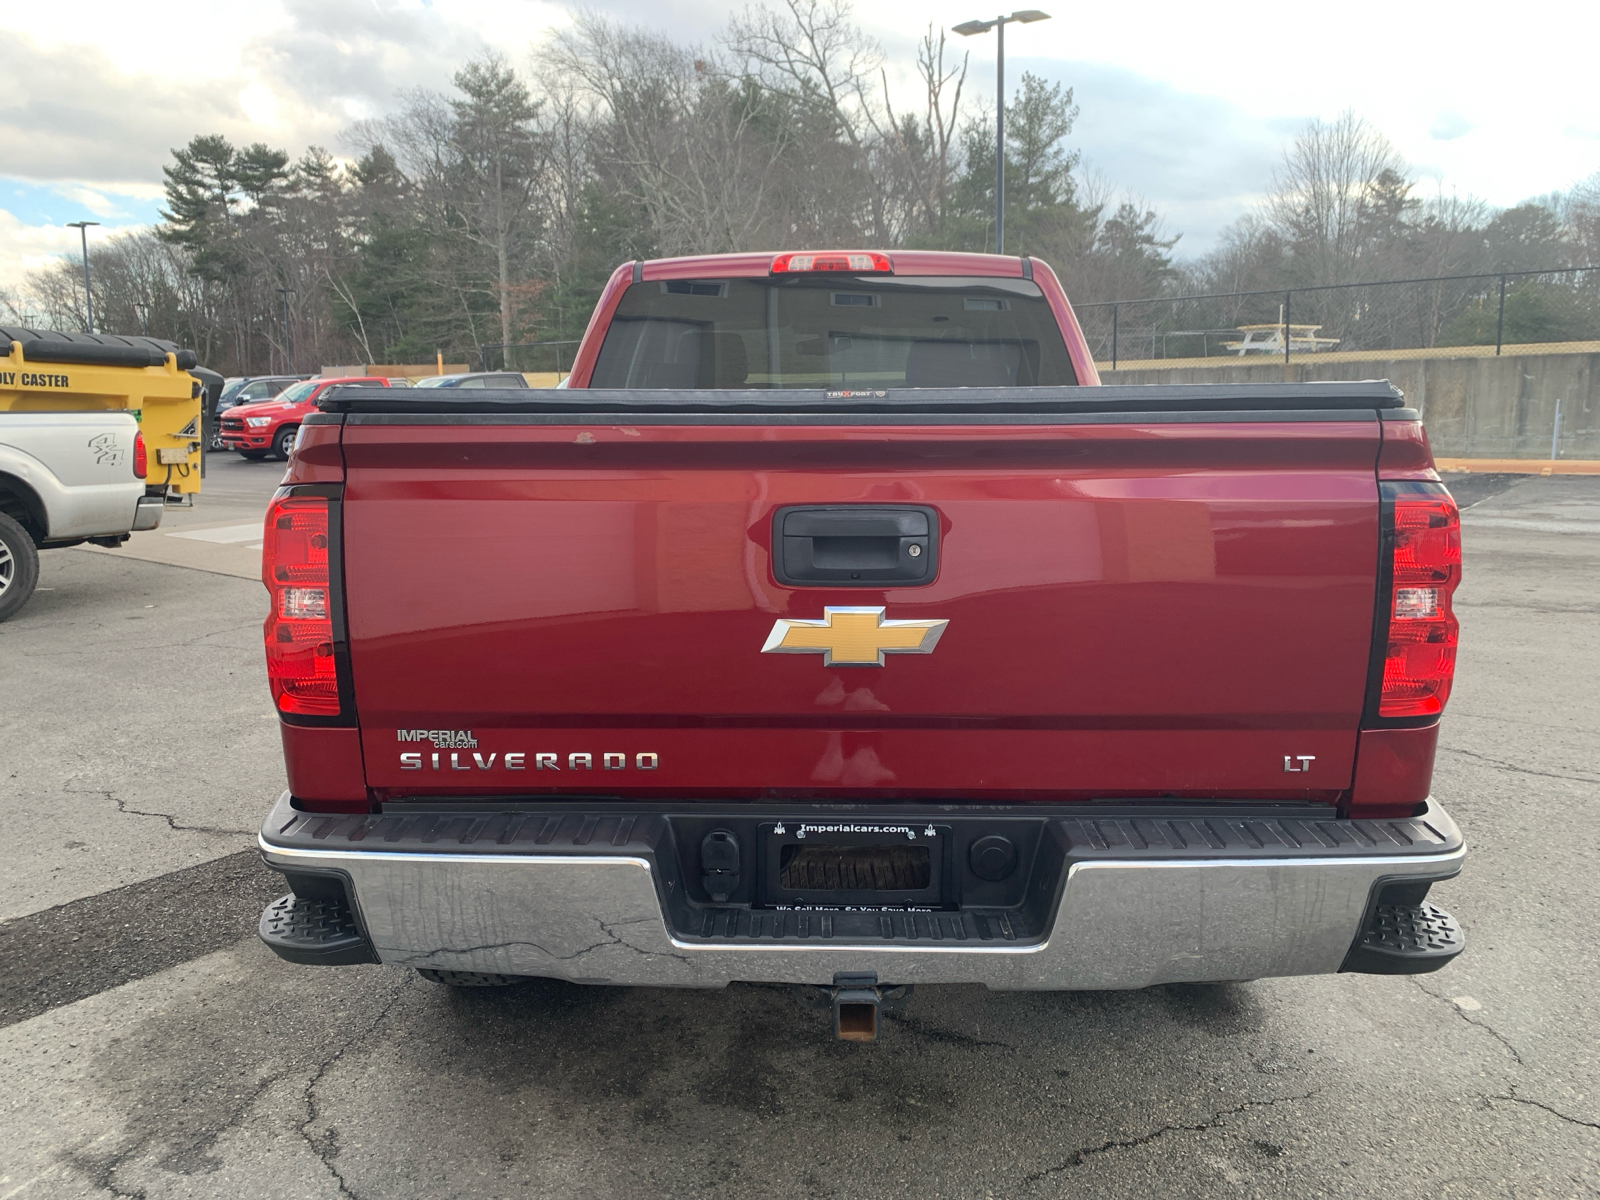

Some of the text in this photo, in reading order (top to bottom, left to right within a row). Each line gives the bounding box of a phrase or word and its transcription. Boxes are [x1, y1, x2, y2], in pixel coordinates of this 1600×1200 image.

[21, 372, 69, 388] CASTER
[397, 729, 477, 742] IMPERIAL
[433, 741, 478, 749] cars.com
[400, 752, 658, 770] SILVERADO
[1283, 755, 1316, 772] LT
[800, 823, 908, 833] Imperialcars.com
